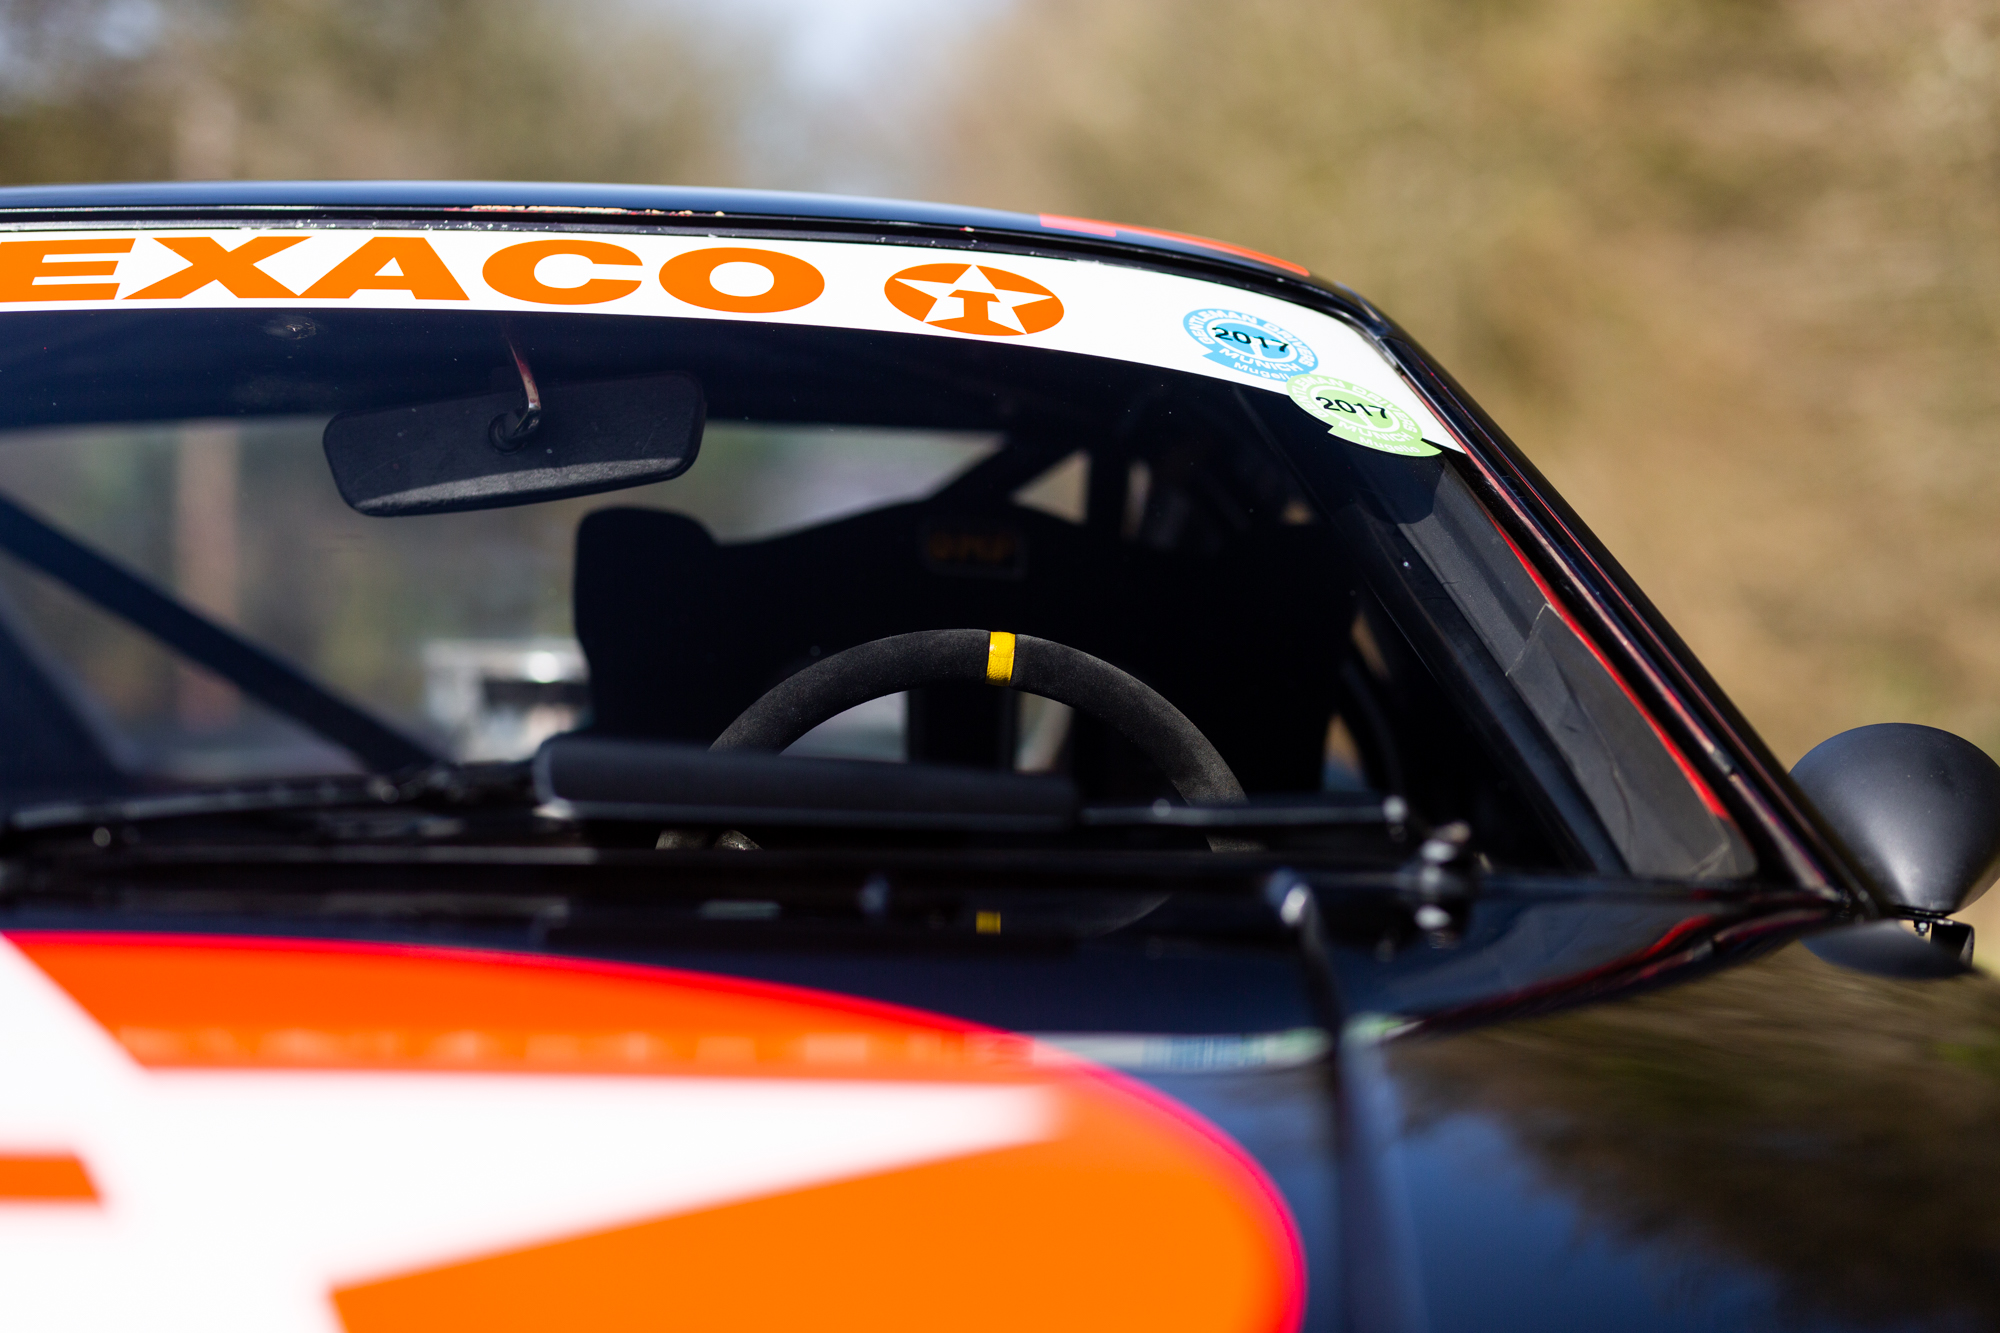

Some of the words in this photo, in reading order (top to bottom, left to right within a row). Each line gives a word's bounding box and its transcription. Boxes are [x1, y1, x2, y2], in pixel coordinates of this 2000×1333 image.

[0, 236, 825, 313] EXACO
[1188, 310, 1258, 345] GENTLEMAN
[1263, 322, 1316, 368] DRIVERS
[1211, 327, 1289, 353] 2017
[1219, 348, 1304, 372] MUNICH
[1233, 362, 1295, 381] Mugell
[1291, 375, 1346, 418] GENTLEMAN
[1352, 386, 1418, 433] DRIVERS
[1315, 397, 1388, 419] 2017
[1338, 421, 1414, 442] MUNICH
[1359, 436, 1421, 453] Mugello
